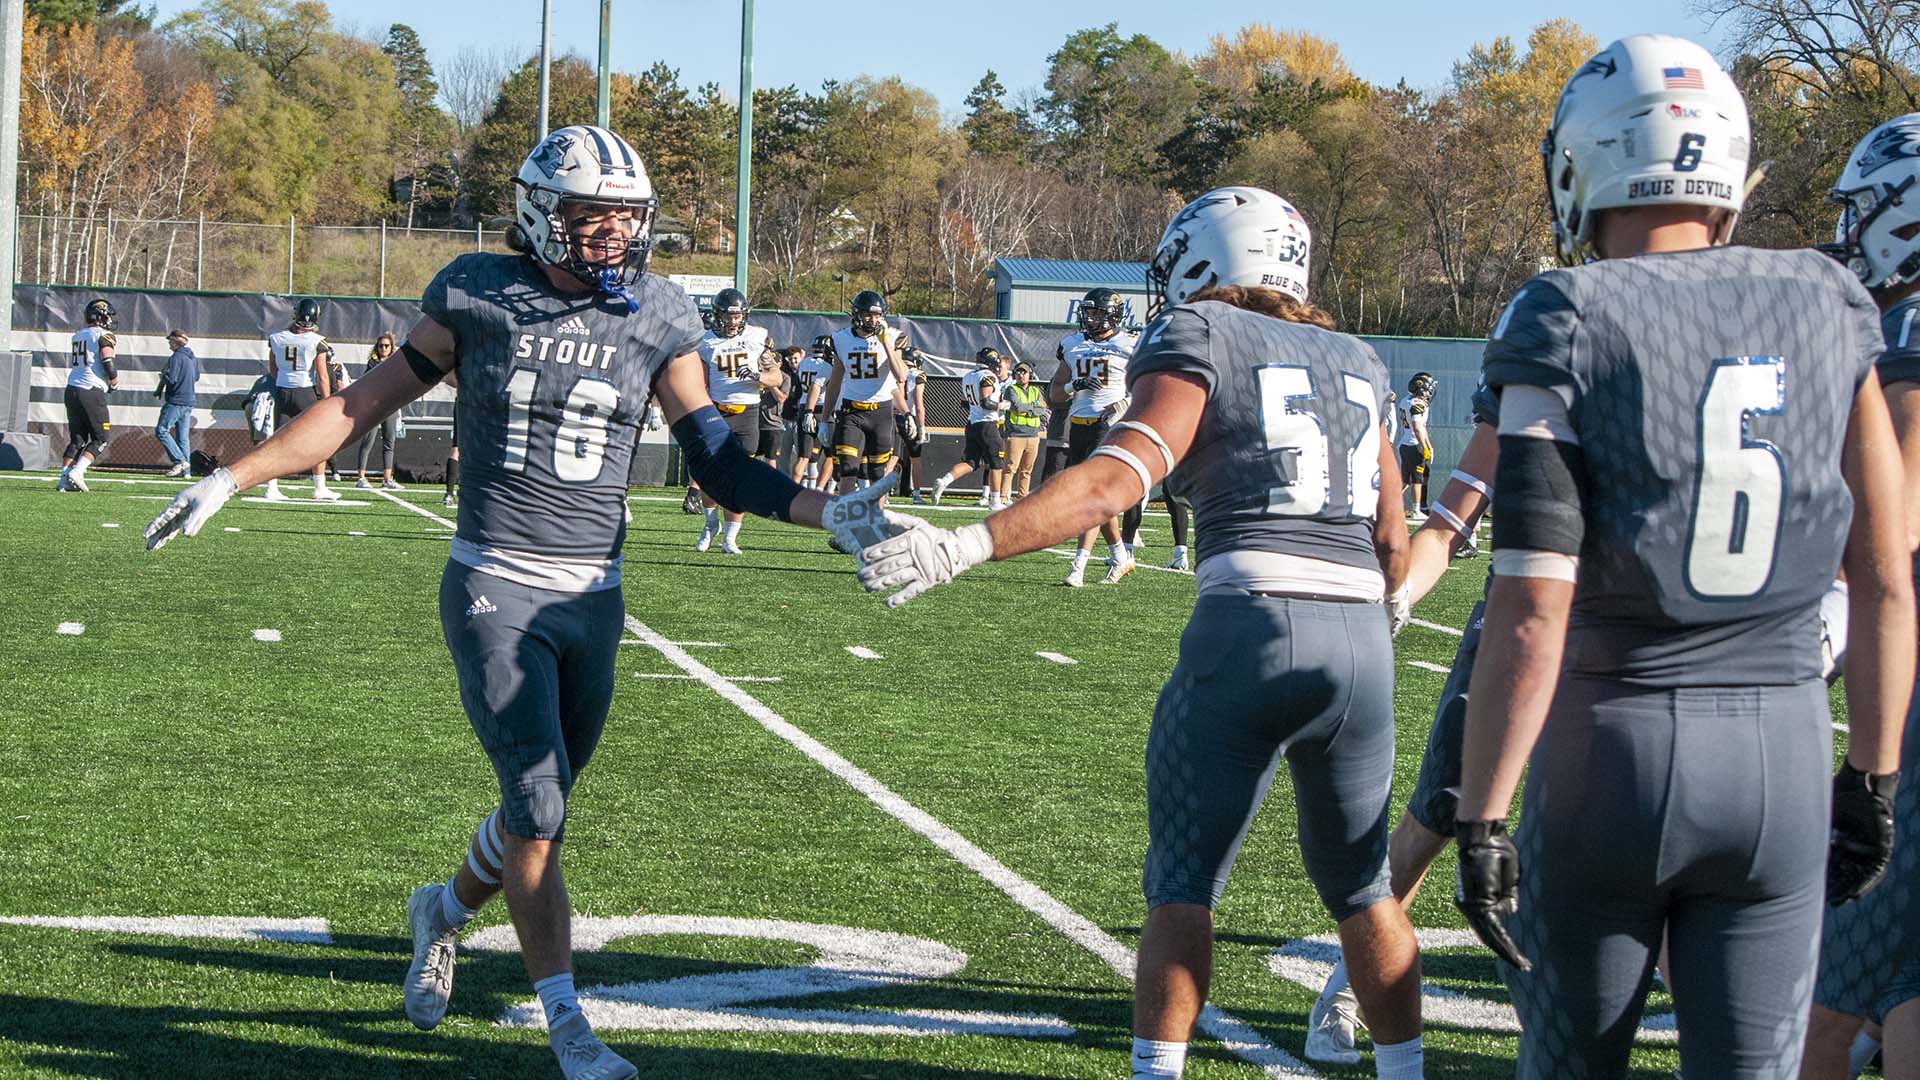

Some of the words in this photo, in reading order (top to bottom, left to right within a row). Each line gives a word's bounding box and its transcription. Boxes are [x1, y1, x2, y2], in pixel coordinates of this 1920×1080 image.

[1673, 132, 1706, 172] 6
[1628, 179, 1675, 199] BLUE
[1685, 179, 1733, 200] DEVILS
[1279, 235, 1307, 268] 52
[1261, 274, 1289, 288] BLUE
[557, 326, 590, 336] adidas
[285, 346, 297, 371] 4
[515, 334, 617, 370] STOUT
[847, 351, 879, 379] 33
[502, 366, 621, 483] 18
[1252, 361, 1381, 521] 52
[1682, 357, 1785, 603] 6
